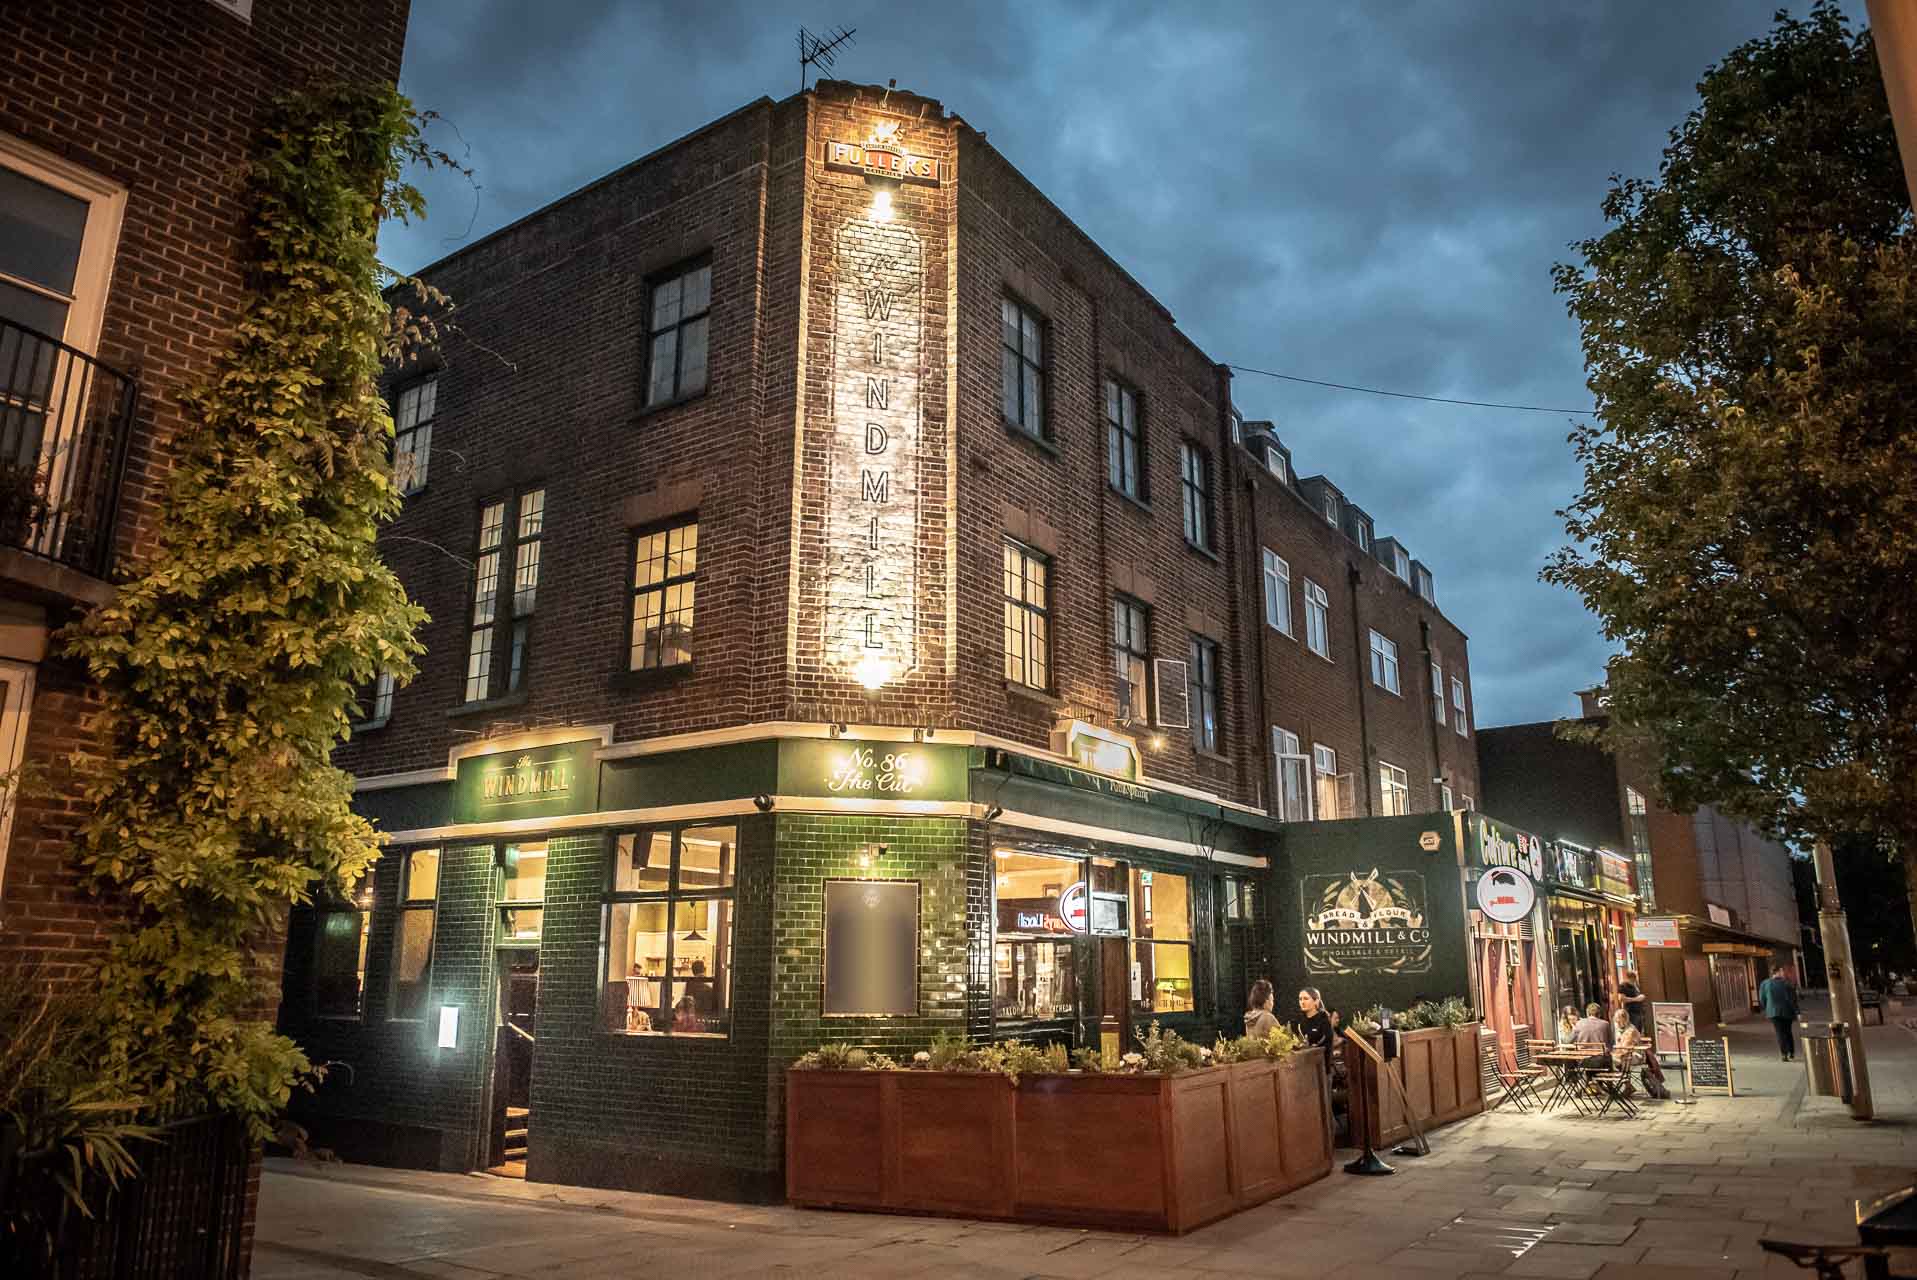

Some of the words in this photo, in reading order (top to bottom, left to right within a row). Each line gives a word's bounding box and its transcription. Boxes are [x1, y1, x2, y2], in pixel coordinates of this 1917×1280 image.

[861, 289, 894, 649] WINDMILL
[880, 752, 913, 773] 86
[483, 767, 570, 799] WINDMILL
[828, 766, 872, 792] The
[1323, 910, 1355, 919] BREAD
[1373, 909, 1405, 919] FLOUR
[1306, 931, 1395, 945] WINDMILL
[1398, 930, 1406, 940] &
